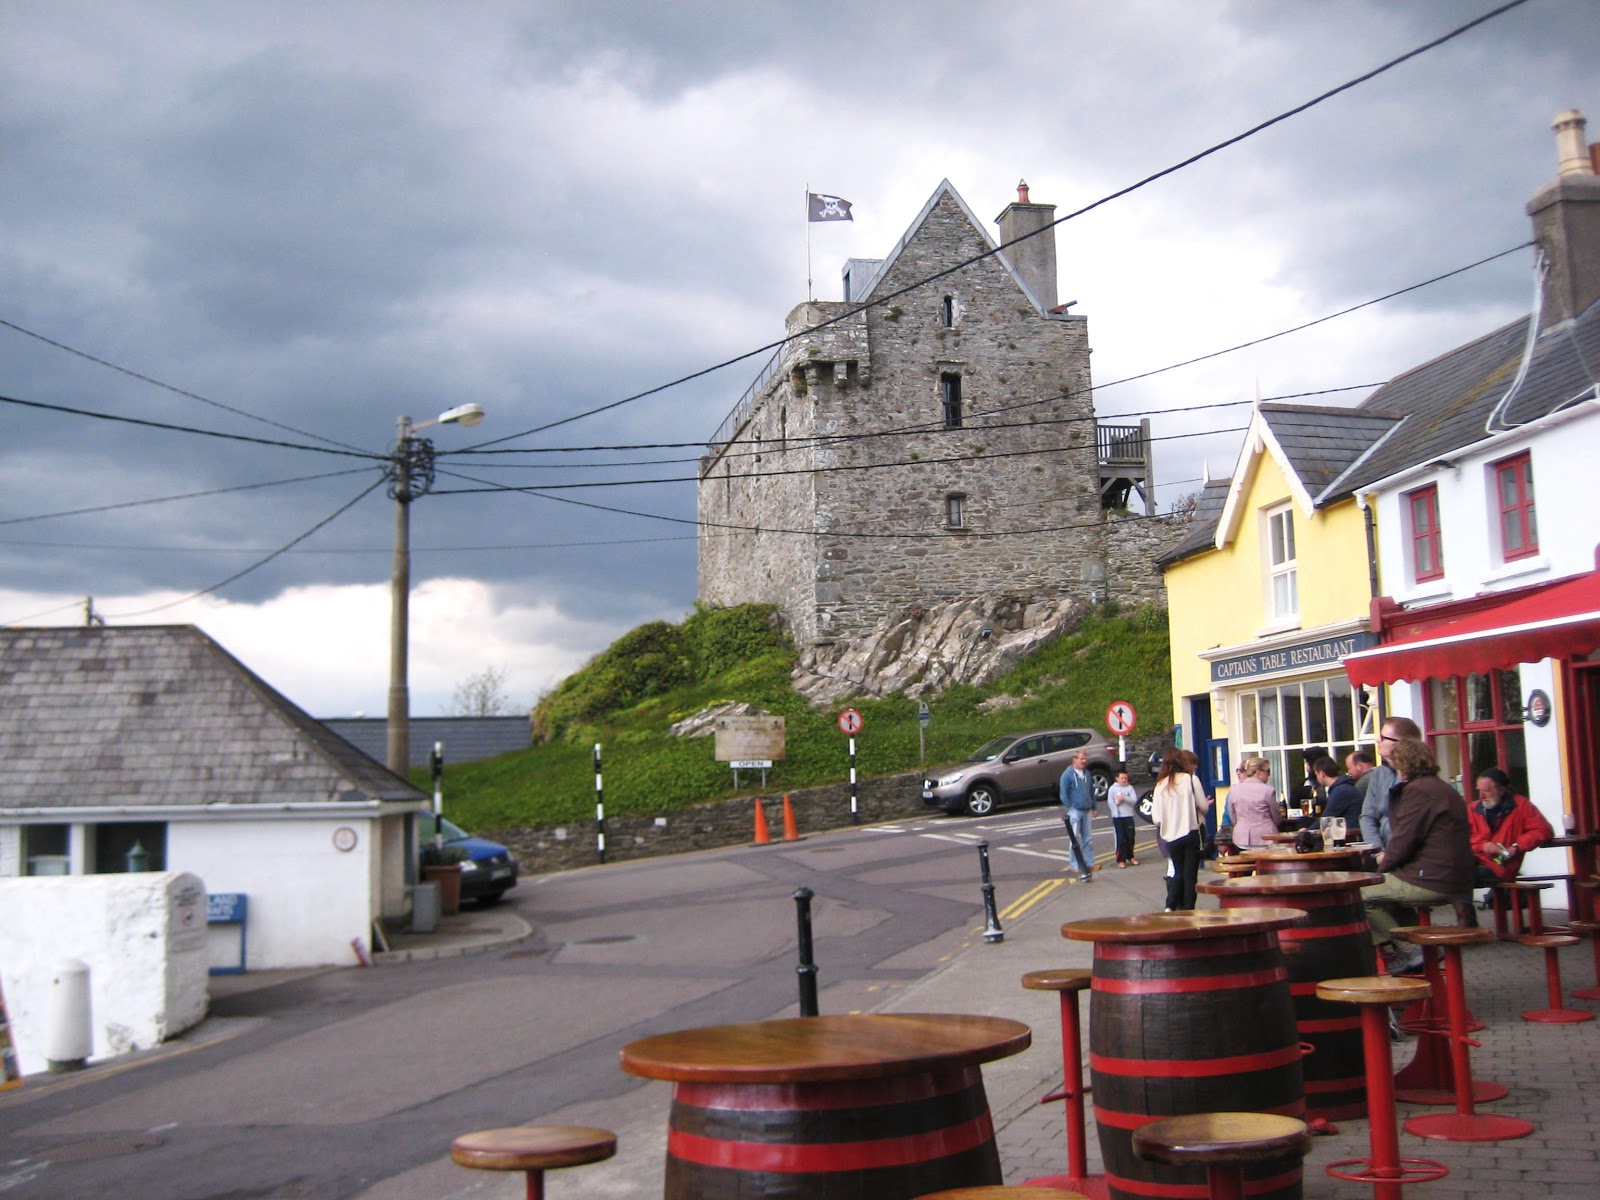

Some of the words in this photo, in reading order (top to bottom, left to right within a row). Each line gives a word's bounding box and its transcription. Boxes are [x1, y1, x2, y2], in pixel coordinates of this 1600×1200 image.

[1217, 656, 1257, 678] CAPTAIN'S
[1260, 652, 1286, 671] TABLE
[1291, 639, 1356, 665] RESTAURANT
